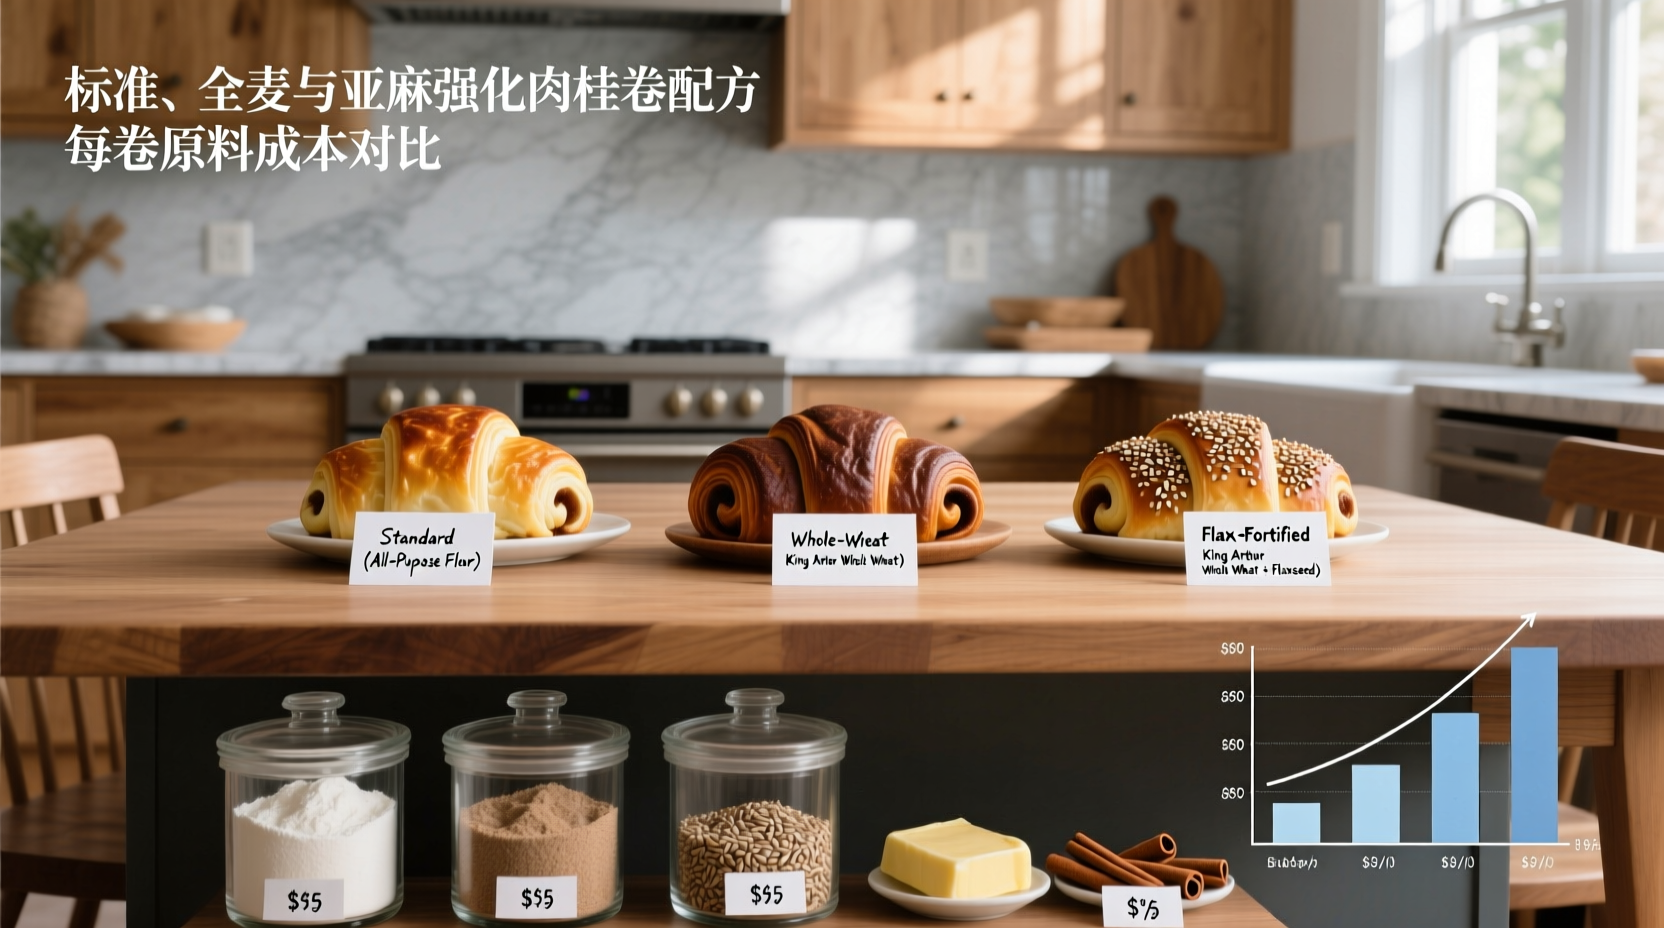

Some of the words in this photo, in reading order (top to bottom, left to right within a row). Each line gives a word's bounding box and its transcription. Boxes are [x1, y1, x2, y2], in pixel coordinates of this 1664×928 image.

[379, 527, 456, 546] Standard
[1202, 525, 1310, 543] Flax-Fortified
[1202, 549, 1228, 564] King
